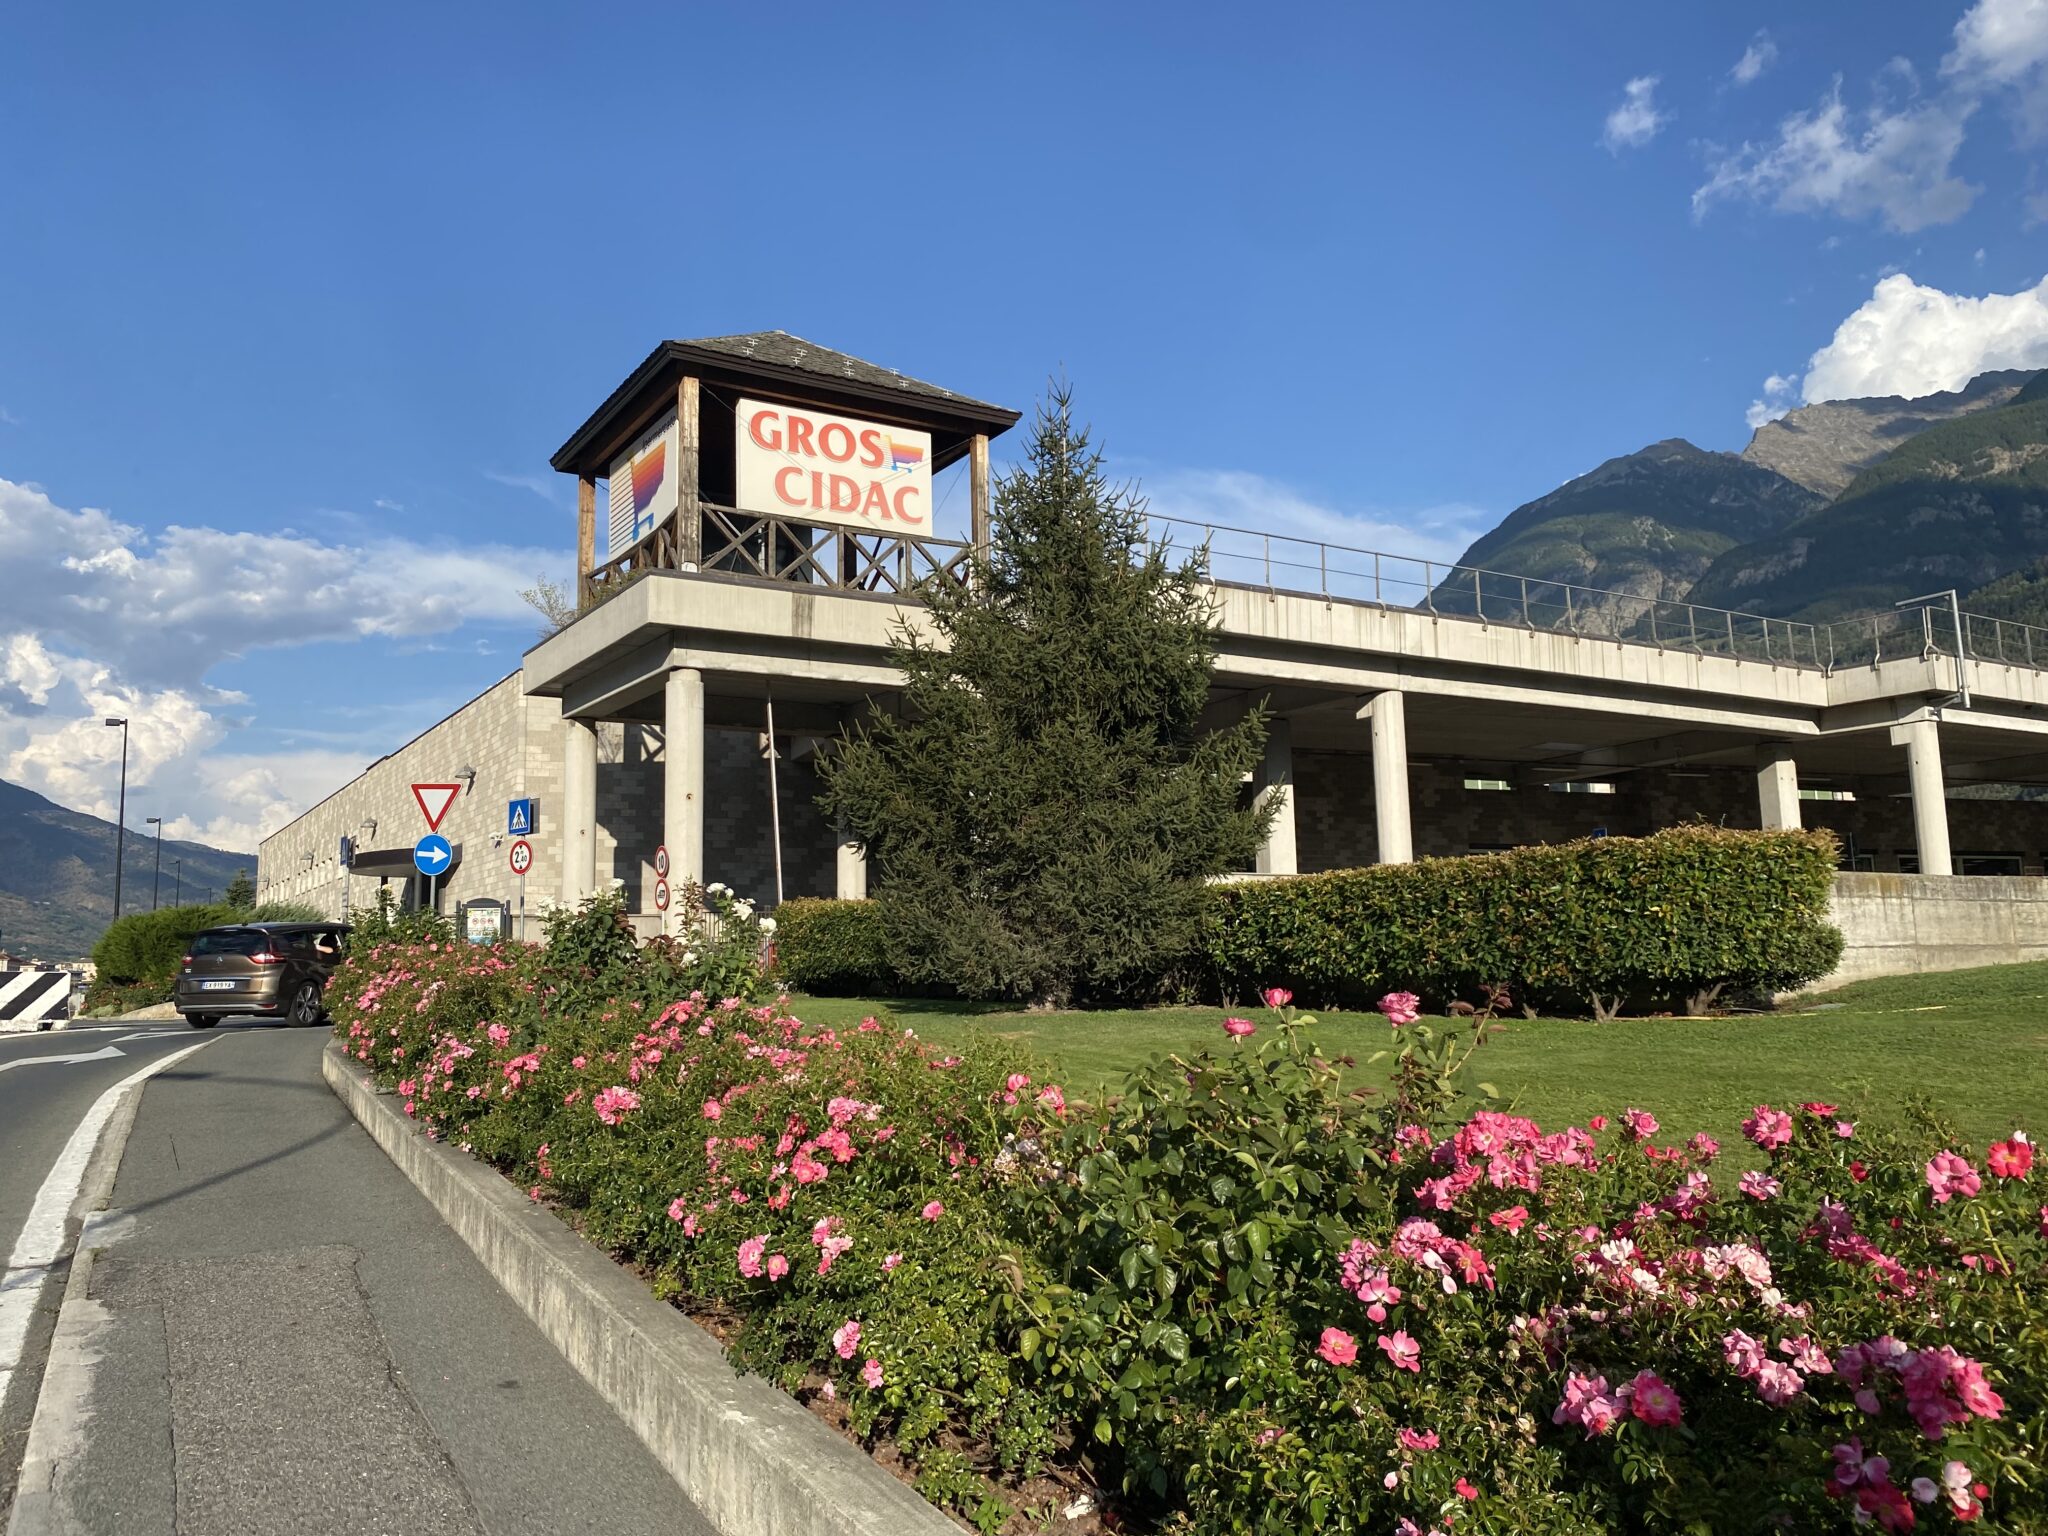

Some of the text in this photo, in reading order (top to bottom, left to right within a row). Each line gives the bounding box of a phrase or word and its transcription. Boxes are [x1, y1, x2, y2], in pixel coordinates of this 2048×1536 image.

[749, 410, 885, 469] GROS
[774, 466, 924, 525] CIDAC
[658, 854, 664, 870] 10
